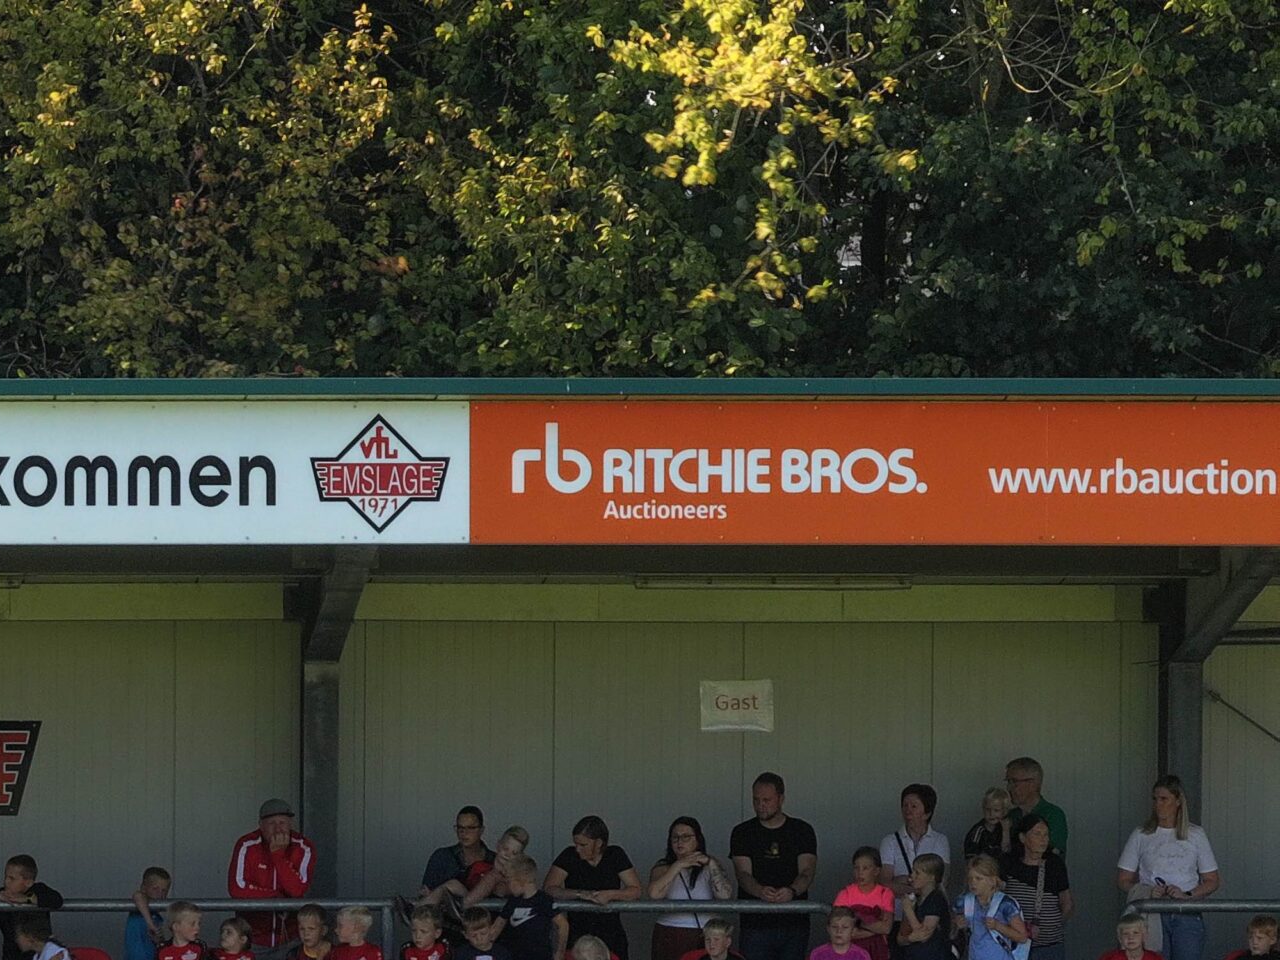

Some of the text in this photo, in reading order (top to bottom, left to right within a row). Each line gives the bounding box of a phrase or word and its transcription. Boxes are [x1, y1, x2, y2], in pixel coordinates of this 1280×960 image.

[511, 422, 928, 494] rb RITCHIE BROS.
[329, 466, 434, 496] EMSLAGE
[988, 458, 1277, 495] www.rbauction
[357, 498, 399, 518] 1971
[603, 501, 727, 520] Auctioneers
[715, 693, 758, 711] Gast
